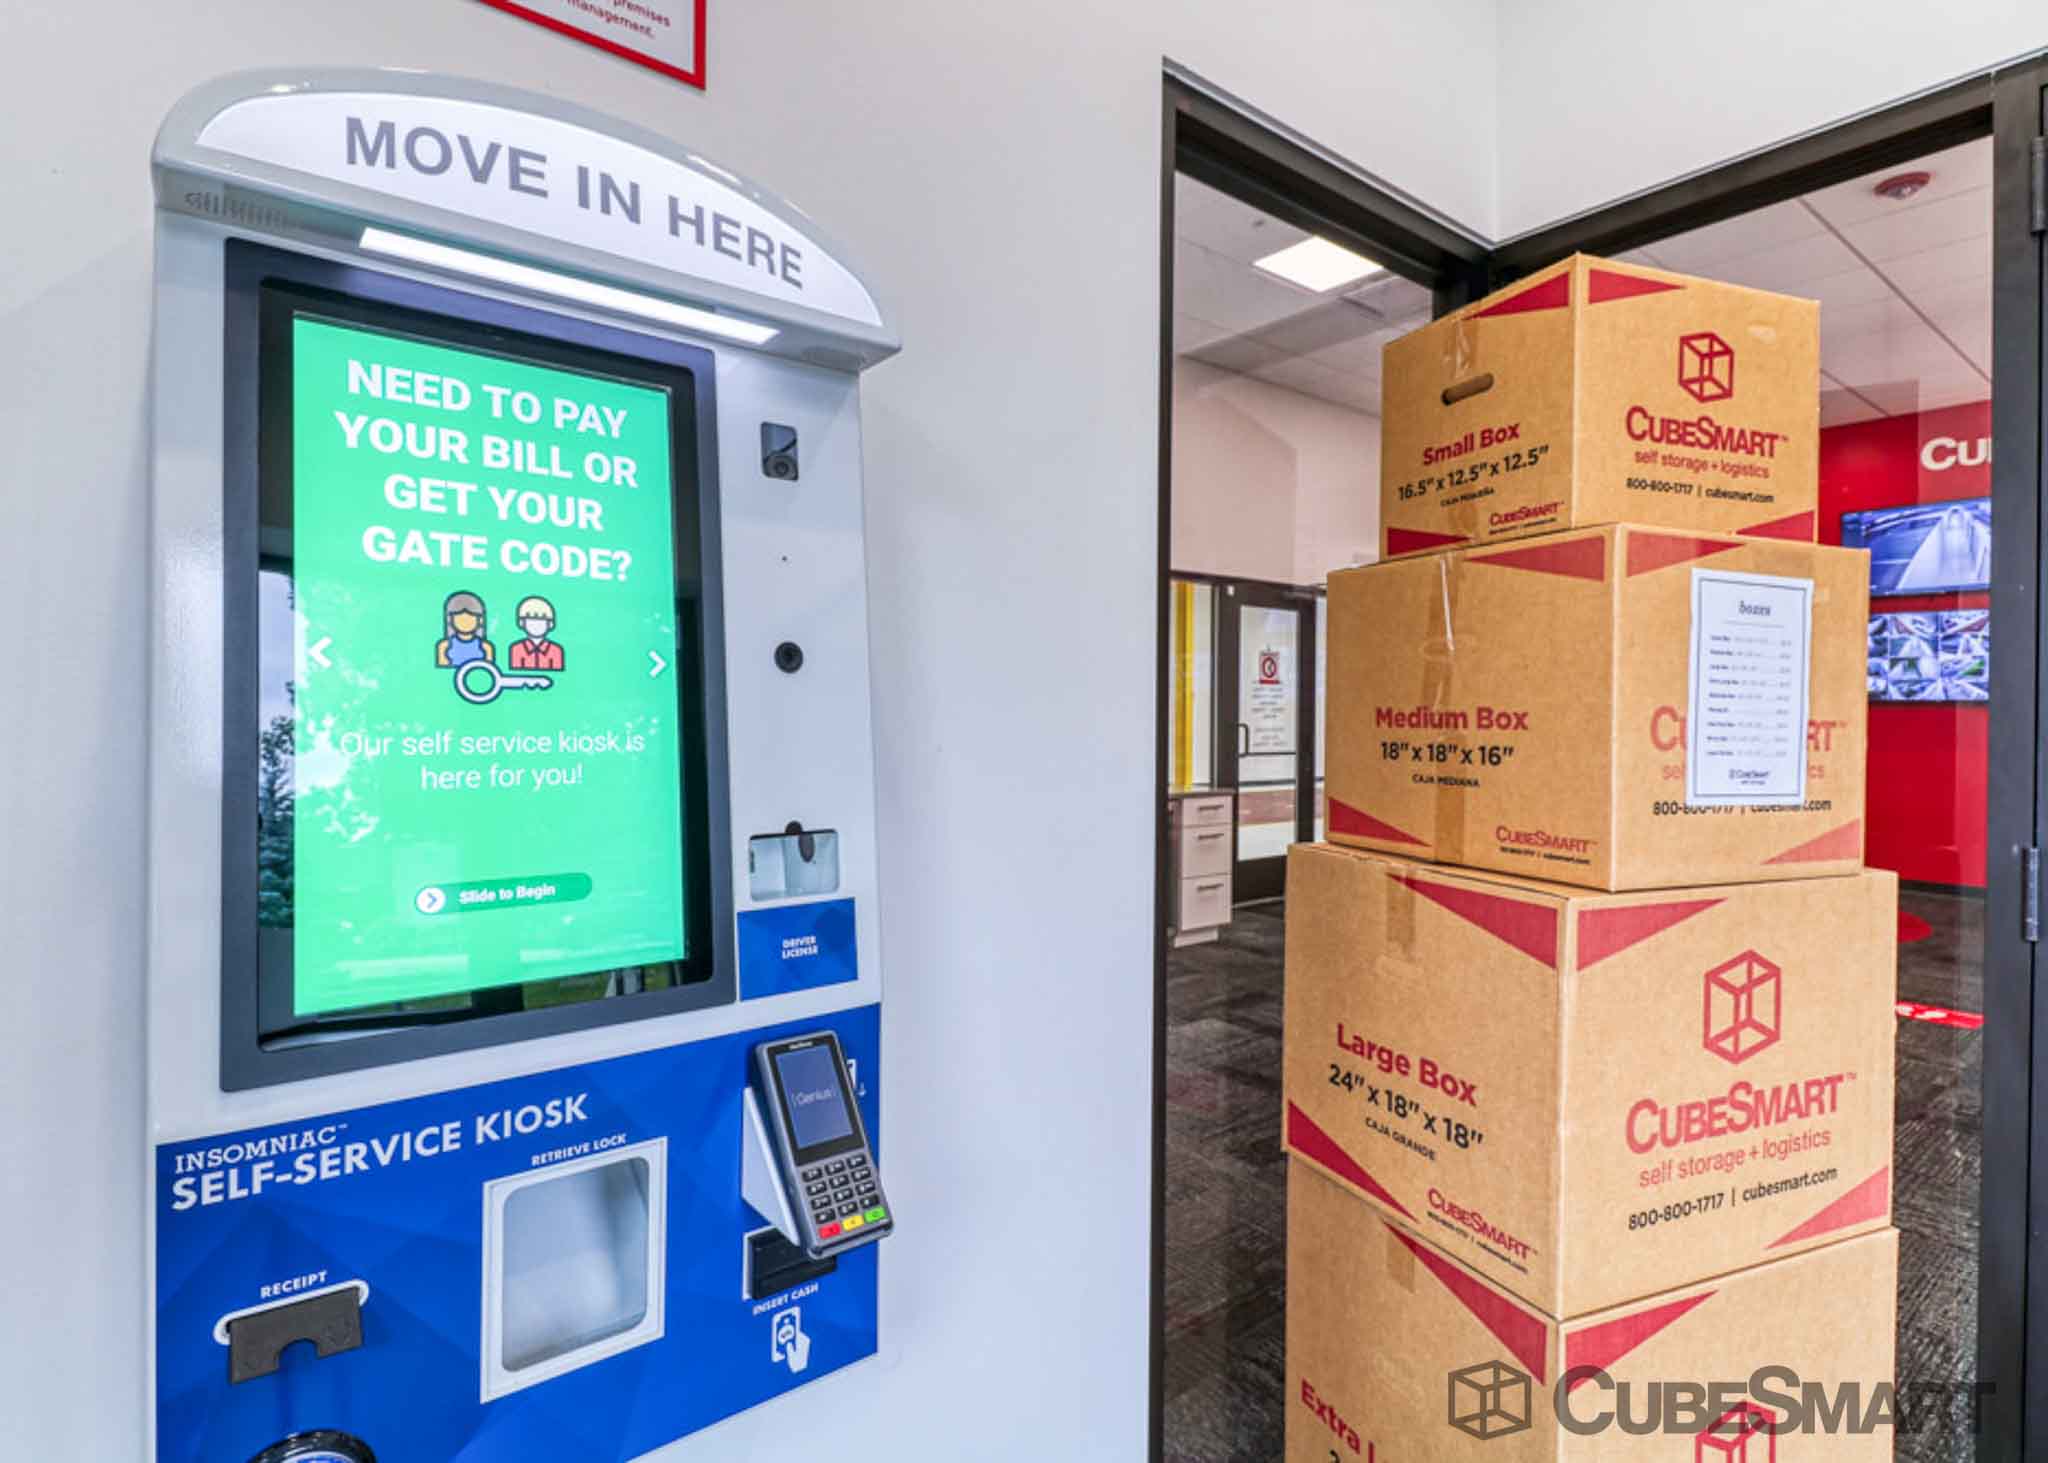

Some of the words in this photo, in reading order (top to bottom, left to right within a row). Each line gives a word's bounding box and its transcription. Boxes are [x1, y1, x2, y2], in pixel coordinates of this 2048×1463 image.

[345, 116, 548, 198] MOVE
[577, 165, 641, 225] IN
[668, 195, 803, 290] HERE
[347, 359, 471, 411] NEED
[482, 384, 541, 424] TO
[553, 400, 627, 438] PAY
[335, 411, 469, 464] YOUR
[482, 434, 573, 479] BILL
[584, 452, 638, 488] OR
[1423, 432, 1475, 466] Small
[1480, 423, 1520, 450] Box
[1920, 436, 1991, 471] CU
[1436, 479, 1445, 491] x
[1490, 462, 1499, 477] x
[1634, 451, 1658, 465] self
[1661, 453, 1708, 474] storage
[1720, 460, 1770, 479] logistics
[384, 474, 477, 516] GET
[488, 487, 604, 531] YOUR
[1626, 477, 1694, 496] 800-800-1717
[1705, 486, 1775, 503] cubesmart.com
[362, 526, 488, 570] GATE
[501, 541, 632, 583] CODE?
[1376, 706, 1468, 730] Medium
[1476, 706, 1529, 730] Box
[340, 732, 393, 757] Our
[401, 730, 453, 756] self
[459, 732, 552, 755] service
[558, 731, 619, 753] kiosk
[625, 731, 646, 752] is
[1381, 740, 1409, 761] 18"
[1411, 747, 1422, 762] x
[1428, 743, 1457, 764] 18"
[1460, 749, 1473, 765] x
[1478, 745, 1514, 767] 16"
[420, 765, 481, 791] here
[489, 763, 526, 788] for
[531, 762, 583, 791] you!
[1412, 773, 1435, 785] CAJA
[459, 889, 496, 905] Slide
[498, 887, 514, 901] to
[516, 884, 556, 901] Begin
[1337, 1023, 1411, 1077] Large
[1419, 1057, 1478, 1108] Box
[1329, 1064, 1365, 1092] 24"
[1368, 1085, 1380, 1106] x
[1385, 1089, 1420, 1119] 18"
[1424, 1112, 1437, 1135] x
[1444, 1117, 1484, 1149] 18"
[172, 1121, 462, 1211] SELF-SERVICE
[475, 1093, 588, 1145] KIOSK
[531, 1142, 591, 1167] RETRIEVE
[593, 1134, 628, 1152] LOCK
[1365, 1117, 1391, 1137] CAJA
[1392, 1131, 1437, 1161] GRANDE
[1639, 1158, 1673, 1188] self
[1679, 1149, 1746, 1180] storage
[1762, 1129, 1832, 1161] logistics
[1628, 1193, 1724, 1231] 800-800-1717
[1742, 1168, 1838, 1201] cubesmart.com
[260, 1270, 328, 1299] RECEIPT
[753, 1293, 789, 1316] INSERT
[791, 1281, 819, 1299] CASH
[1301, 1378, 1361, 1455] Extra
